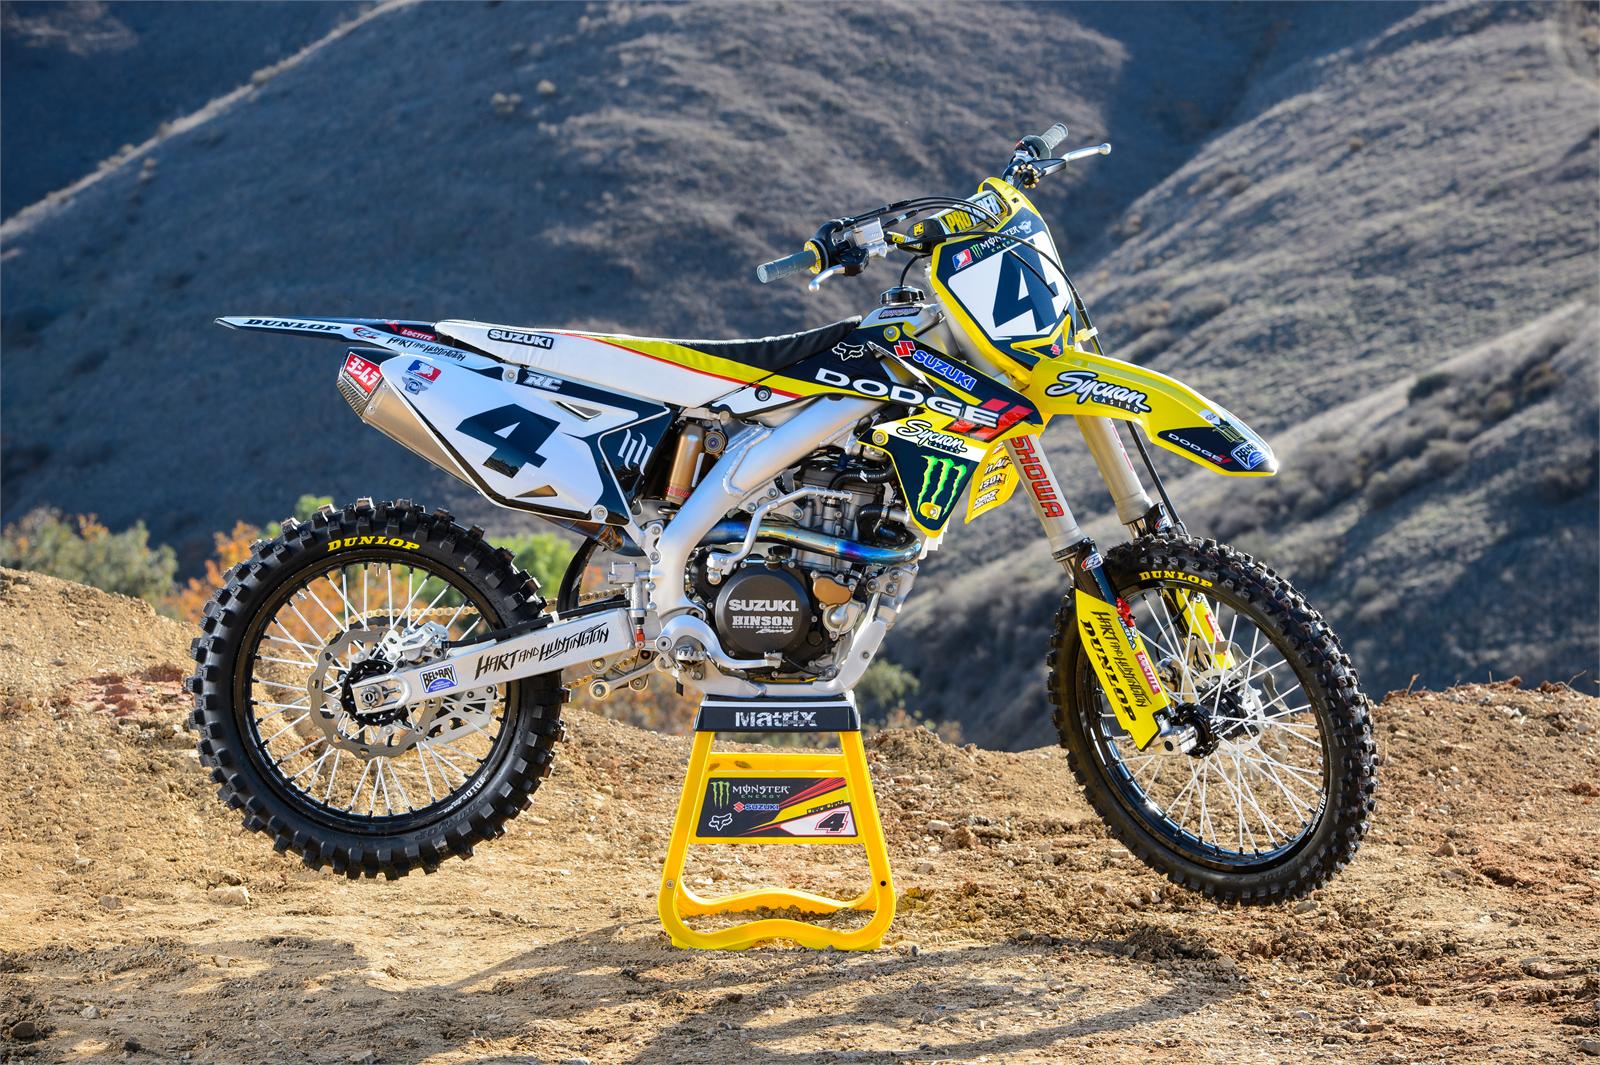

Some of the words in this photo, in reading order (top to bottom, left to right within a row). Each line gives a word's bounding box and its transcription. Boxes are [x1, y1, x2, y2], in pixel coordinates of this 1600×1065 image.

[992, 237, 1058, 332] 4
[243, 318, 342, 331] DUNLOP
[401, 329, 434, 341] LOCTITE
[488, 329, 553, 349] SUZUKI
[912, 349, 977, 391] SUZUKI
[815, 367, 1000, 428] DODGE
[1046, 371, 1152, 412] Sycuan
[1093, 396, 1139, 413] CASINO
[455, 403, 561, 479] 4
[896, 419, 967, 452] Sycuan
[1168, 433, 1223, 463] DODGE
[1010, 435, 1065, 518] SHOWA
[327, 535, 421, 552] DUNLOP
[1139, 570, 1213, 588] DUNLOP
[728, 599, 798, 612] SUZUKI
[732, 615, 794, 626] HINSON
[1091, 611, 1120, 642] HART
[474, 649, 521, 680] HART
[519, 647, 540, 663] AND
[539, 622, 609, 662] HUNTINGTON
[1080, 619, 1137, 721] DUNLOP
[1137, 653, 1160, 692] LOCTITE
[735, 710, 818, 727] Matrix
[732, 784, 791, 794] MONSTER
[745, 803, 780, 811] SUZUKI
[815, 811, 849, 833] 4
